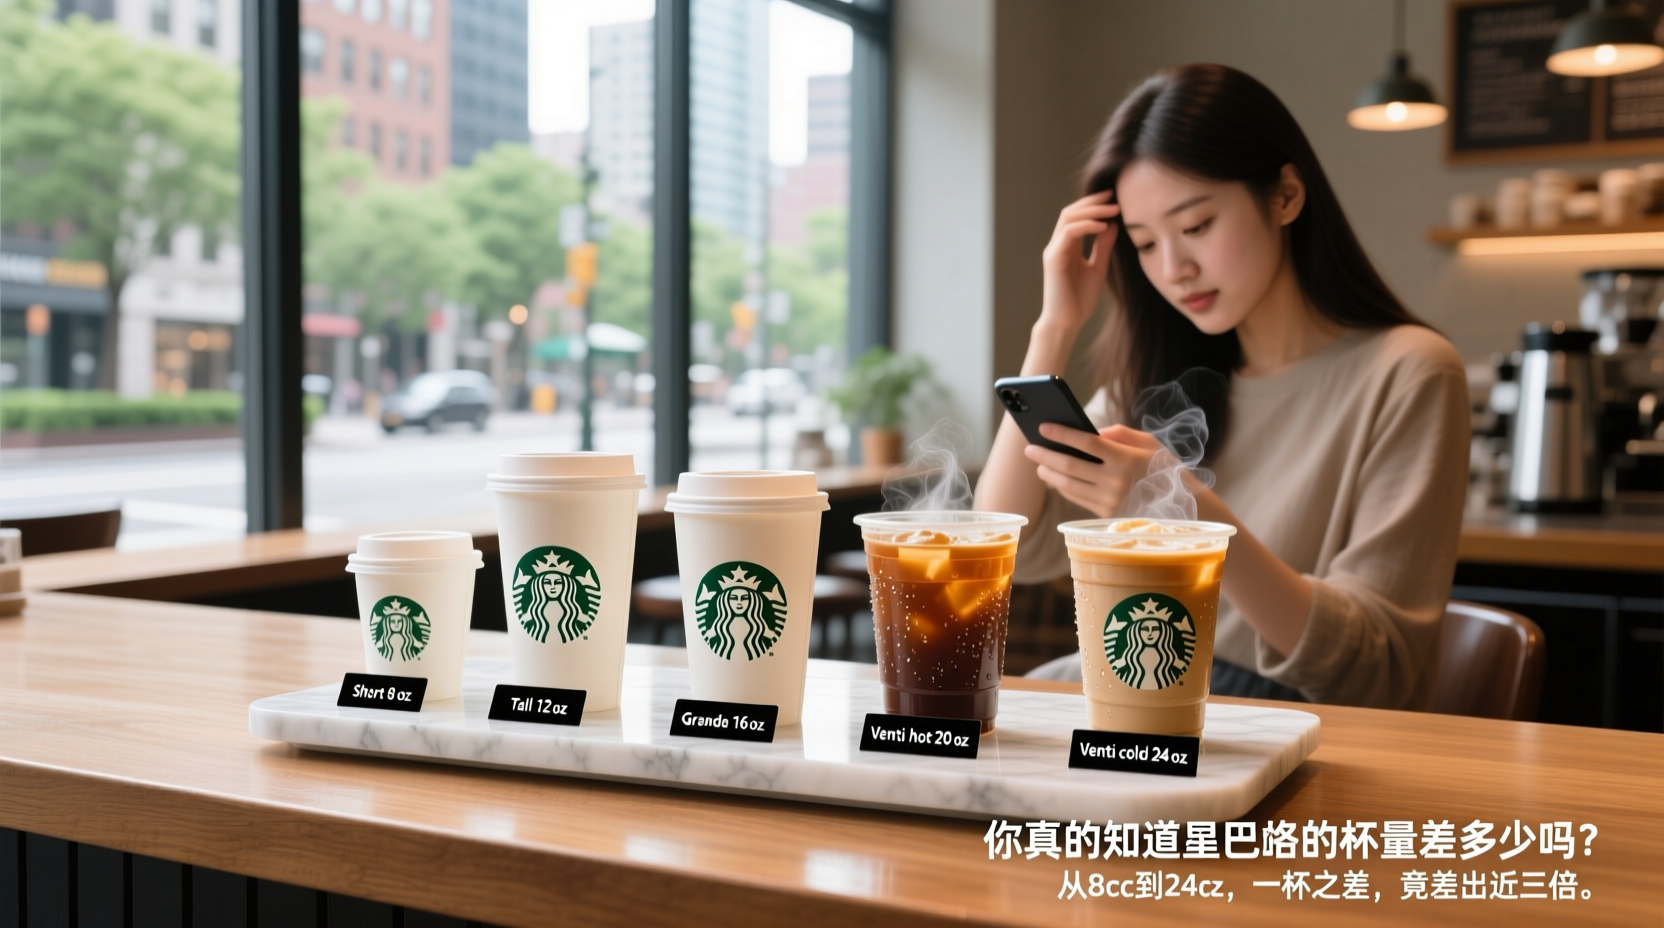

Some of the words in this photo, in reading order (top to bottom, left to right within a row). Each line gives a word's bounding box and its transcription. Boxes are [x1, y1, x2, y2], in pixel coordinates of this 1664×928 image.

[396, 690, 413, 702] oz
[510, 697, 534, 712] Tall
[537, 698, 552, 714] 12
[552, 704, 568, 715] oz
[732, 715, 749, 730] 16
[749, 720, 765, 732] oz
[870, 725, 906, 743] Venti
[908, 727, 933, 744] hot
[934, 730, 952, 746] 20
[953, 735, 970, 747] oz
[1079, 742, 1116, 759] Venti
[1118, 744, 1149, 761] cold
[1150, 746, 1170, 762] 24
[1170, 752, 1188, 765] oz
